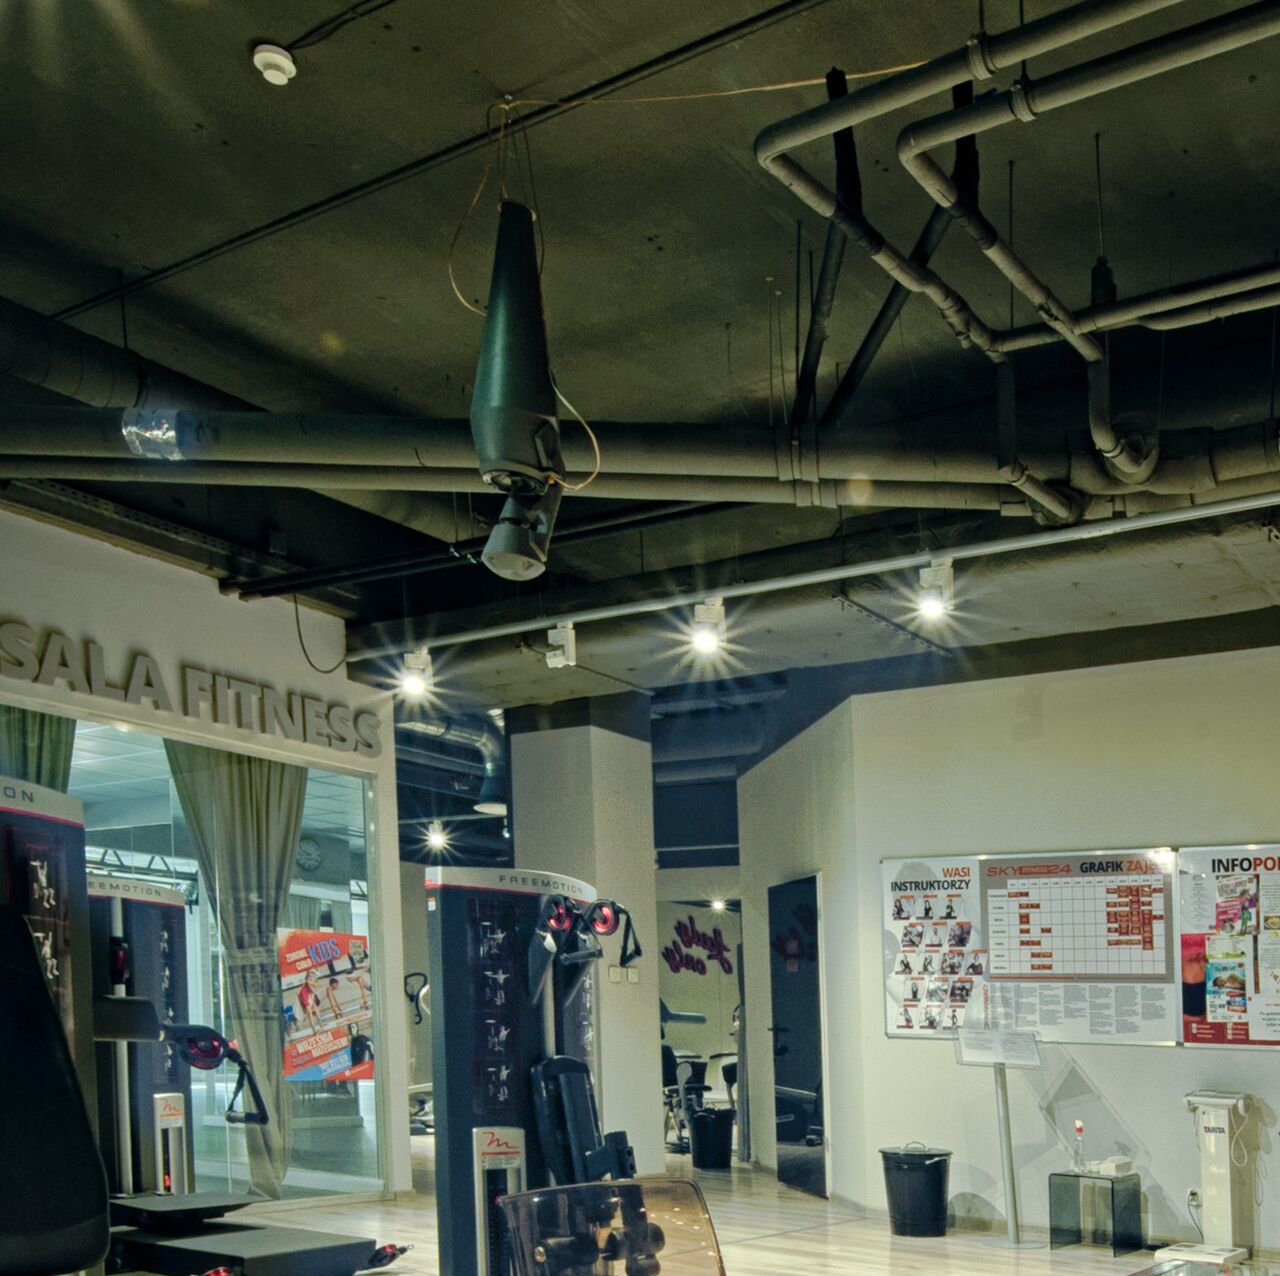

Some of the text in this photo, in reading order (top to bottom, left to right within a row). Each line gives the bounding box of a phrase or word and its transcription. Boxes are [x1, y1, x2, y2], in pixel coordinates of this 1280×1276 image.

[182, 665, 383, 758] FITNESS
[942, 866, 970, 878] WASI
[1080, 861, 1123, 873] GRAFIK
[87, 880, 162, 897] EEMOTION
[499, 873, 584, 895] FREEMOTION
[891, 879, 971, 892] INSTRUKTORZY
